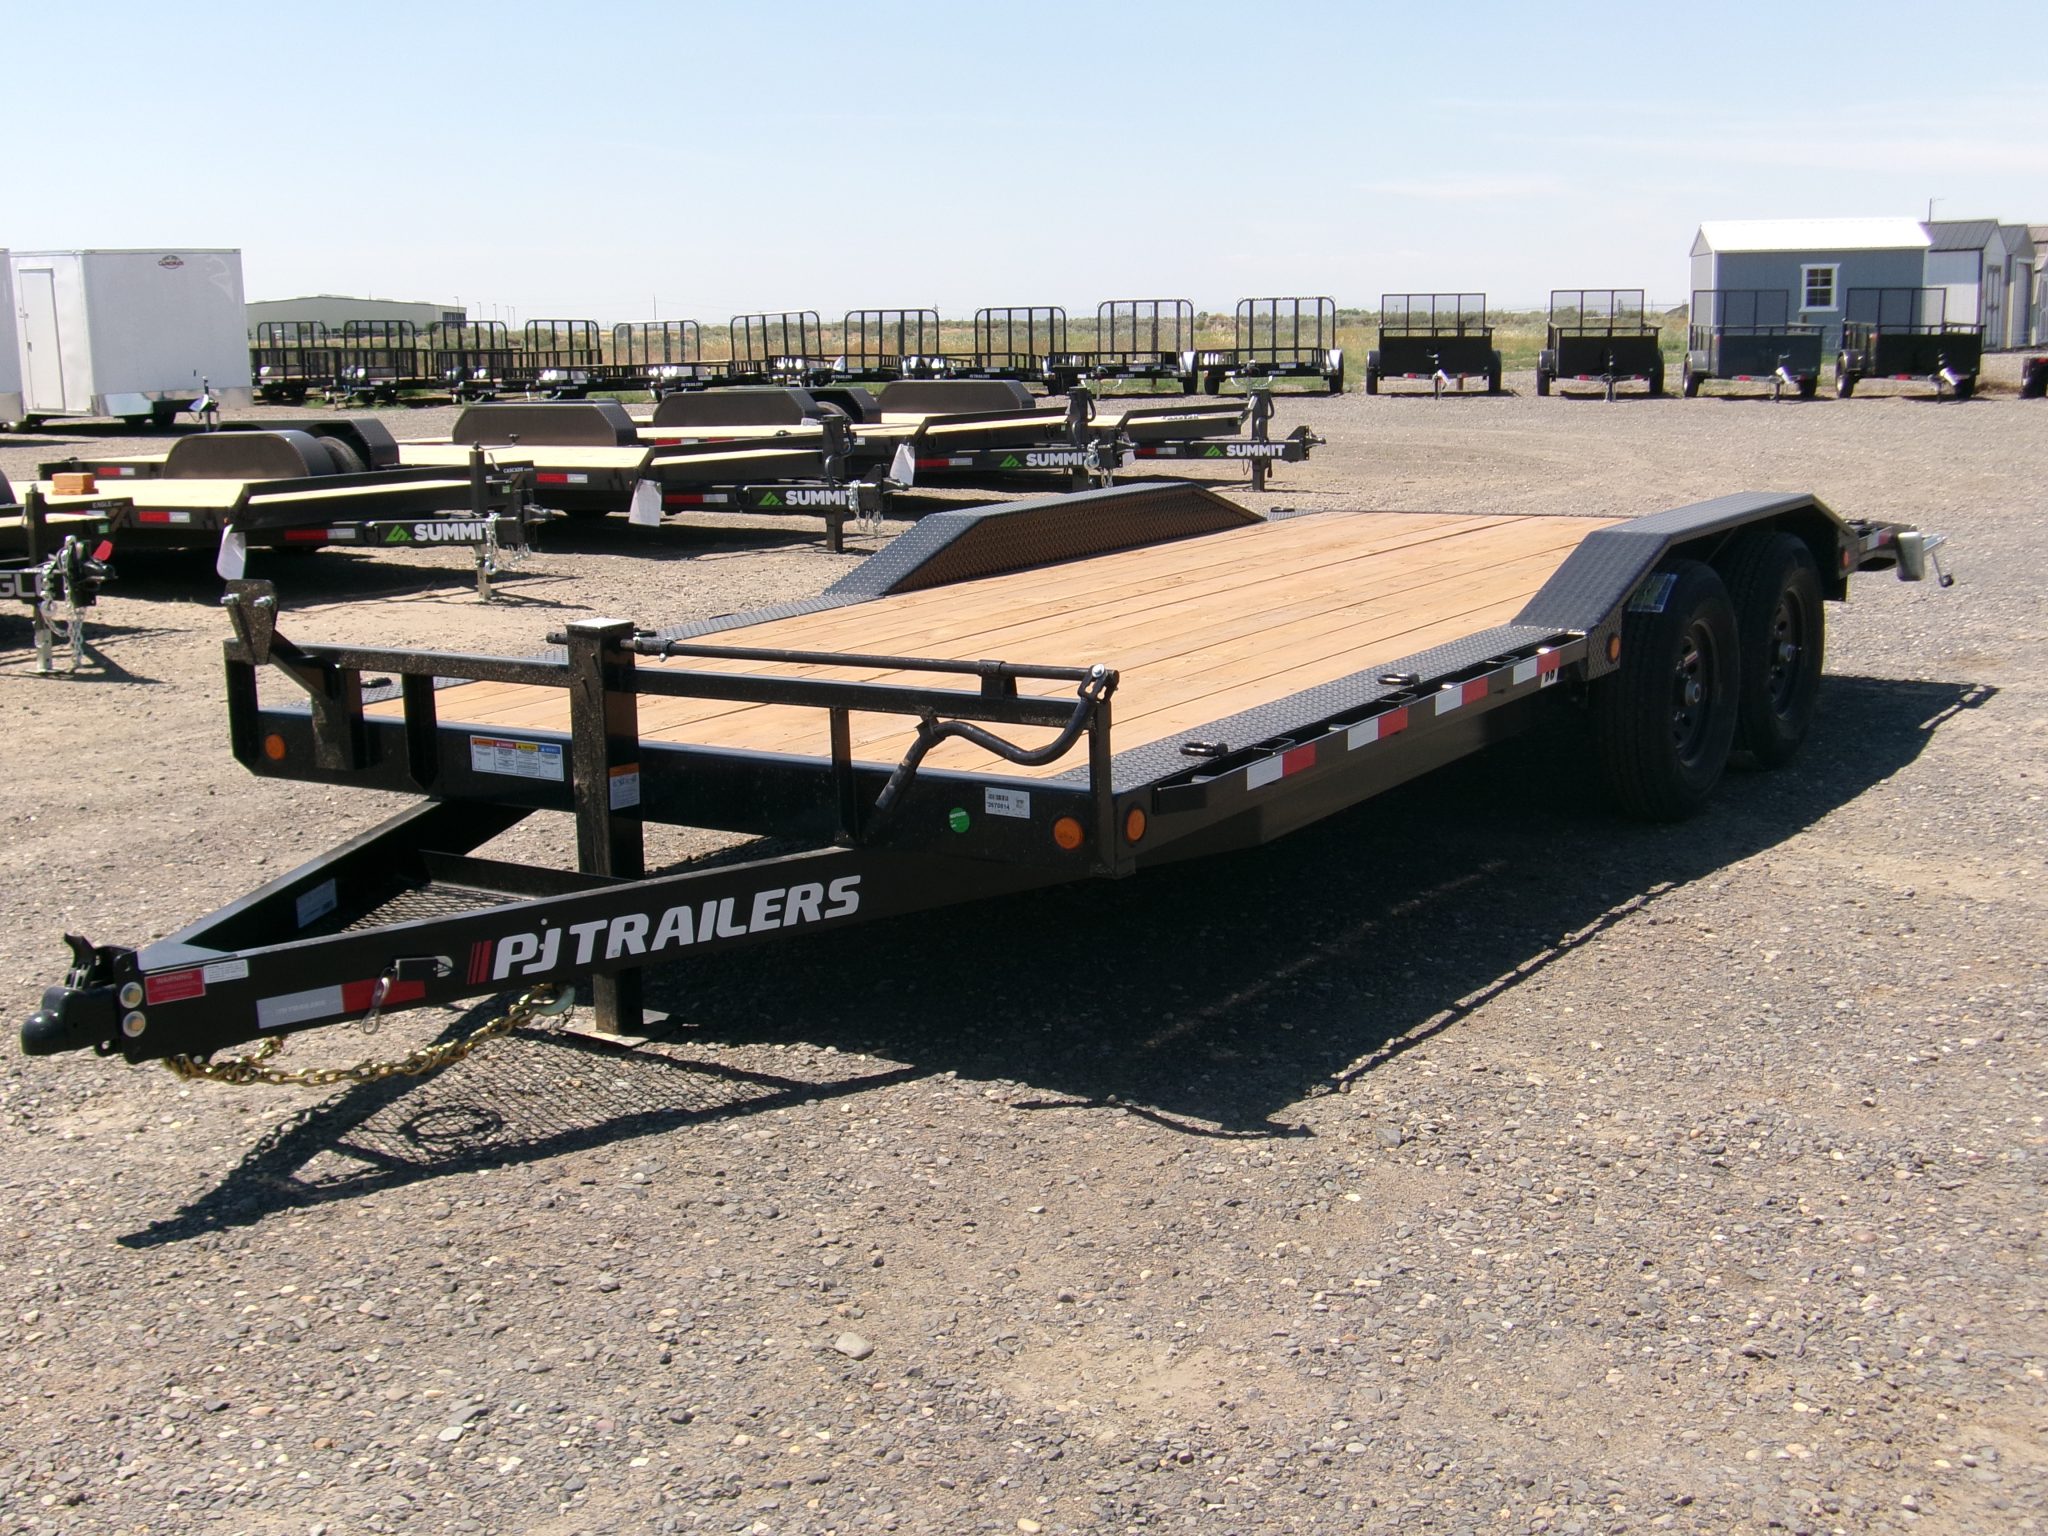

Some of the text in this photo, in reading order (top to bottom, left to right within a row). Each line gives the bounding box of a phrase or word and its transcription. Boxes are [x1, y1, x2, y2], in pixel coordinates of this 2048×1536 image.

[1226, 444, 1285, 457] SUMMIT
[492, 874, 862, 980] PJ TRAILERS
